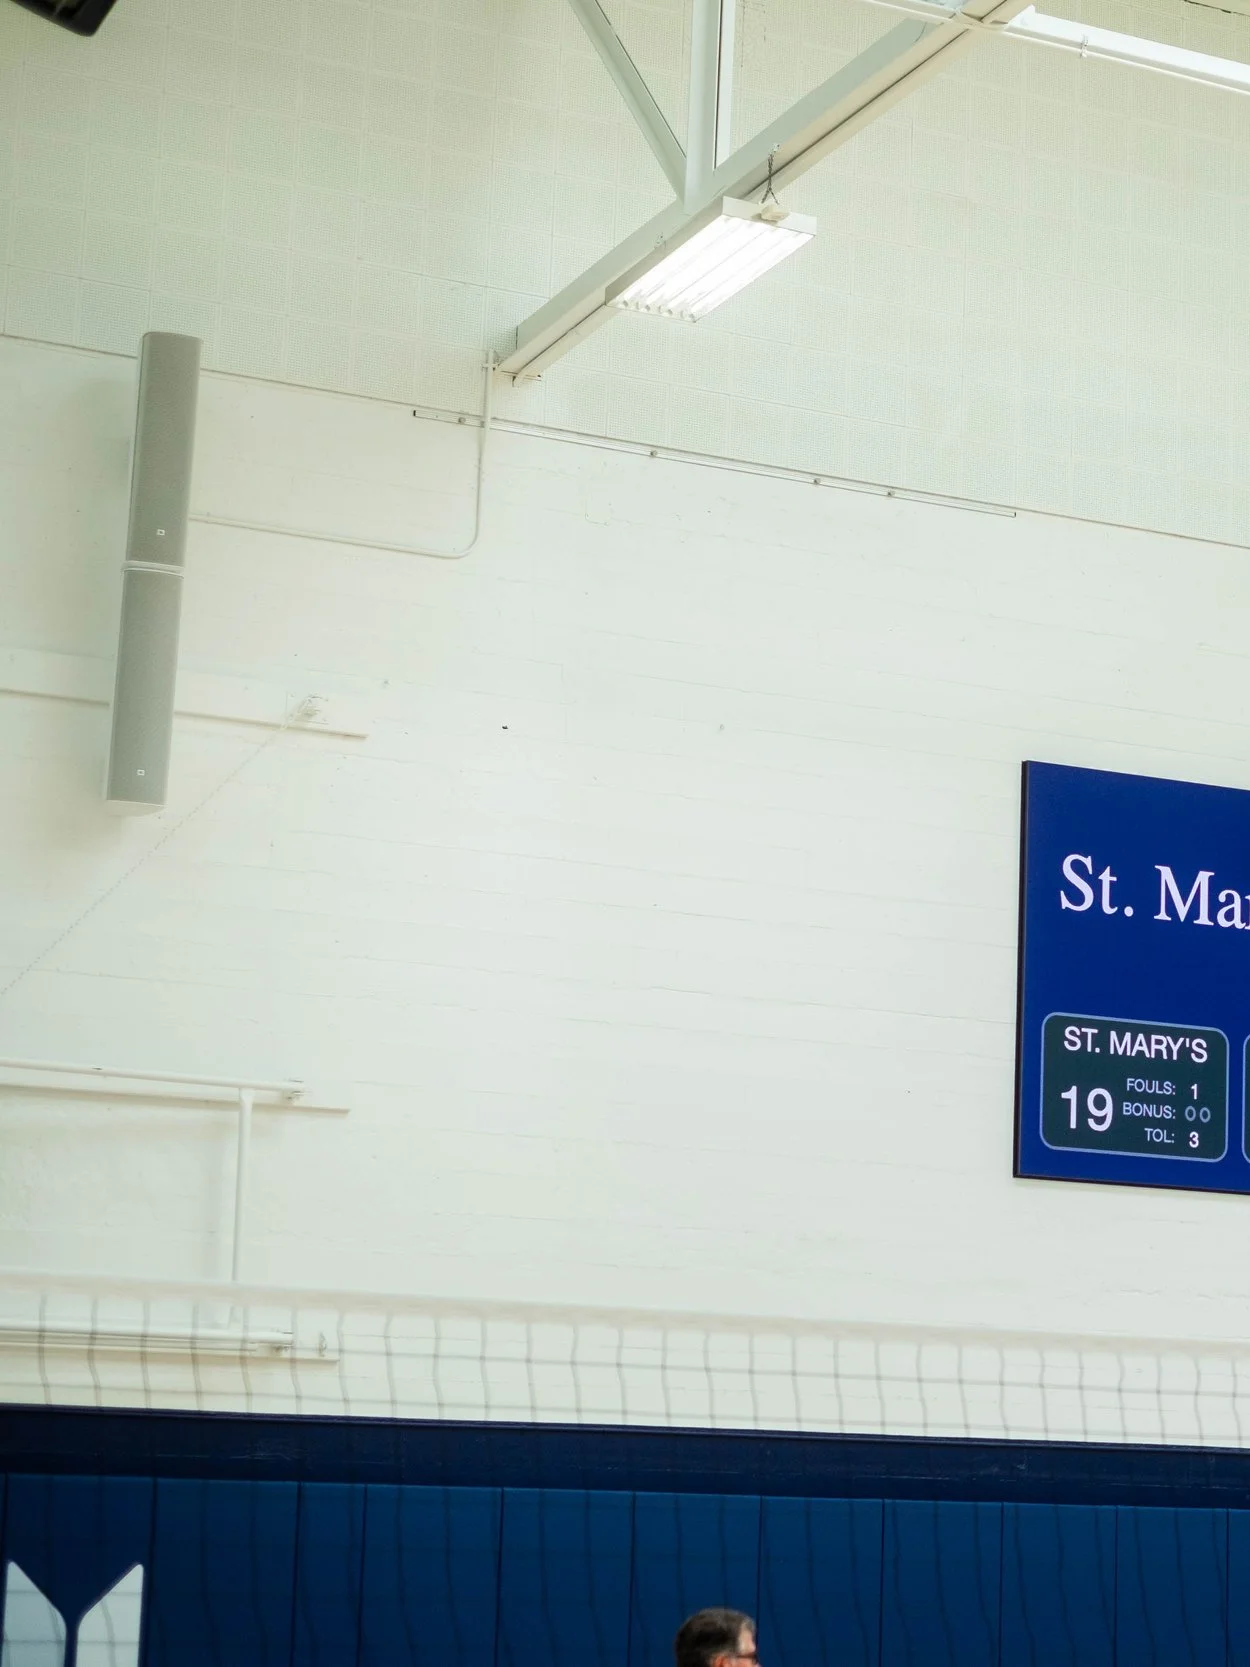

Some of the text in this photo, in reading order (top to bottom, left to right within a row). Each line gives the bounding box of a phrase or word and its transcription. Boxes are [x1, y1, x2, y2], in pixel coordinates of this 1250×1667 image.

[1060, 853, 1134, 918] St.
[1063, 1025, 1209, 1064] ST. MARY'S
[1126, 1077, 1198, 1100] FOULS: 1
[1060, 1085, 1114, 1132] 19
[1122, 1101, 1176, 1120] BONUS:
[1144, 1127, 1200, 1149] TOL: 3
